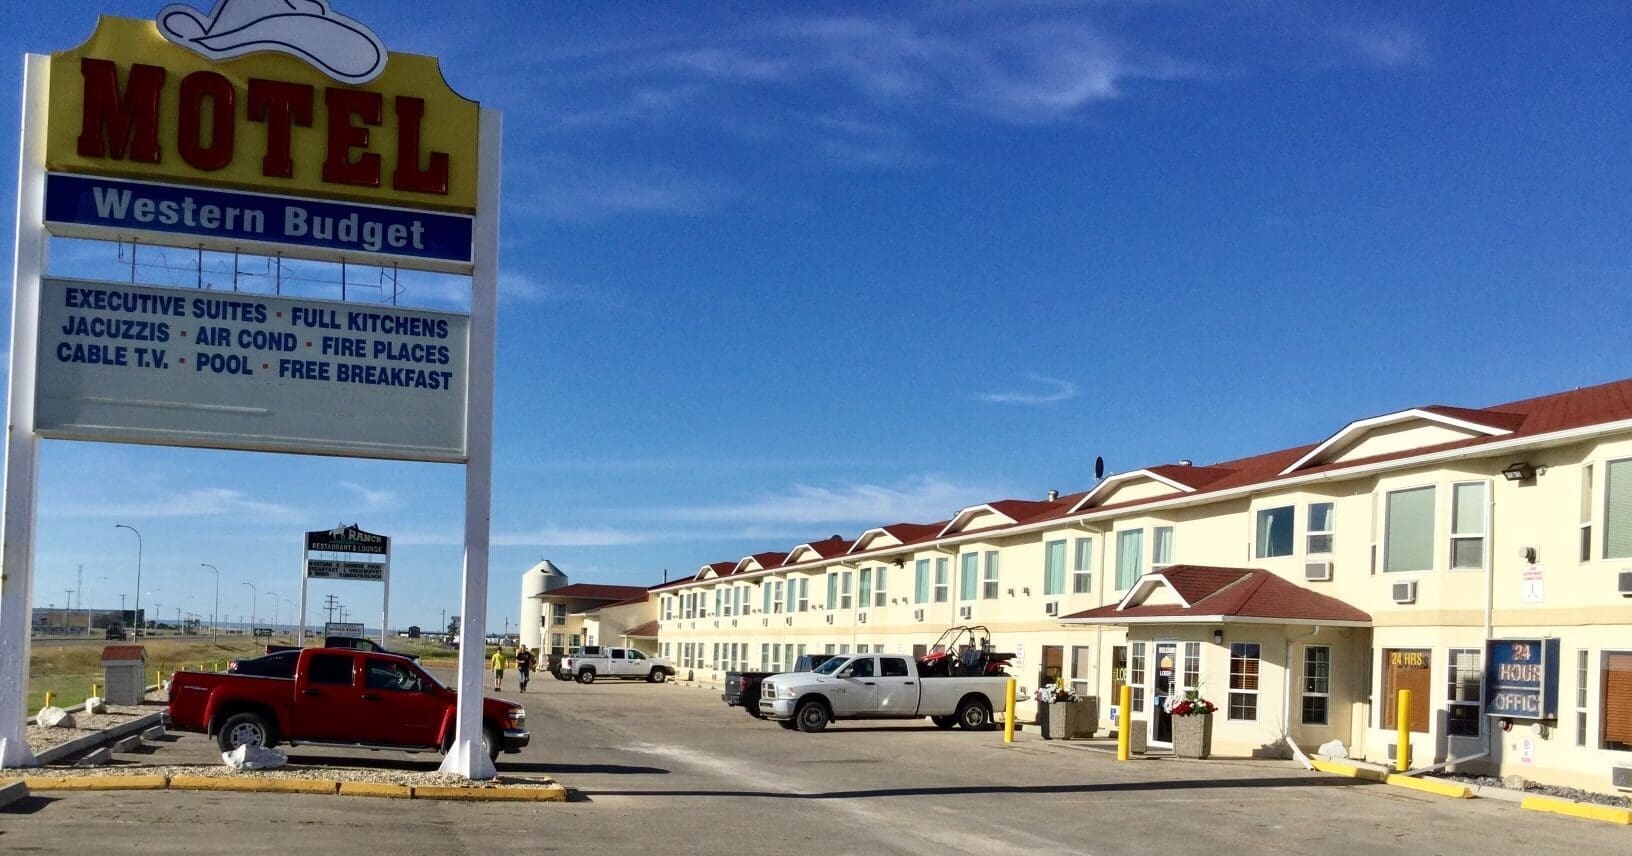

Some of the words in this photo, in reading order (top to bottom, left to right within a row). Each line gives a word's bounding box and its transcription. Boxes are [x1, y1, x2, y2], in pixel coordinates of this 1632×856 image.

[77, 57, 450, 195] MOTEL
[93, 187, 265, 233] Western
[284, 206, 425, 251] Budget
[65, 287, 185, 316] EXECUTIVE
[192, 298, 267, 323] SUITES
[291, 306, 341, 329] FULL
[348, 311, 449, 339] KITCHENS
[62, 315, 170, 342] JACUZZIS
[195, 326, 231, 347] AIR
[238, 329, 297, 351] COND
[322, 336, 366, 358] FIRE
[373, 340, 449, 365] PLACES
[56, 342, 127, 366] CABLE
[134, 347, 168, 369] T.V.
[196, 352, 253, 375] POOL
[279, 358, 330, 381] FREE
[337, 363, 452, 390] BREAKFAST
[312, 542, 351, 551] RESTAURANT
[358, 545, 382, 553] LOUNGE
[348, 529, 381, 543] RANCH
[1391, 652, 1402, 665] 24
[1404, 652, 1422, 666] HRS
[1513, 644, 1531, 661] 24
[1495, 693, 1541, 712] OFFIC
